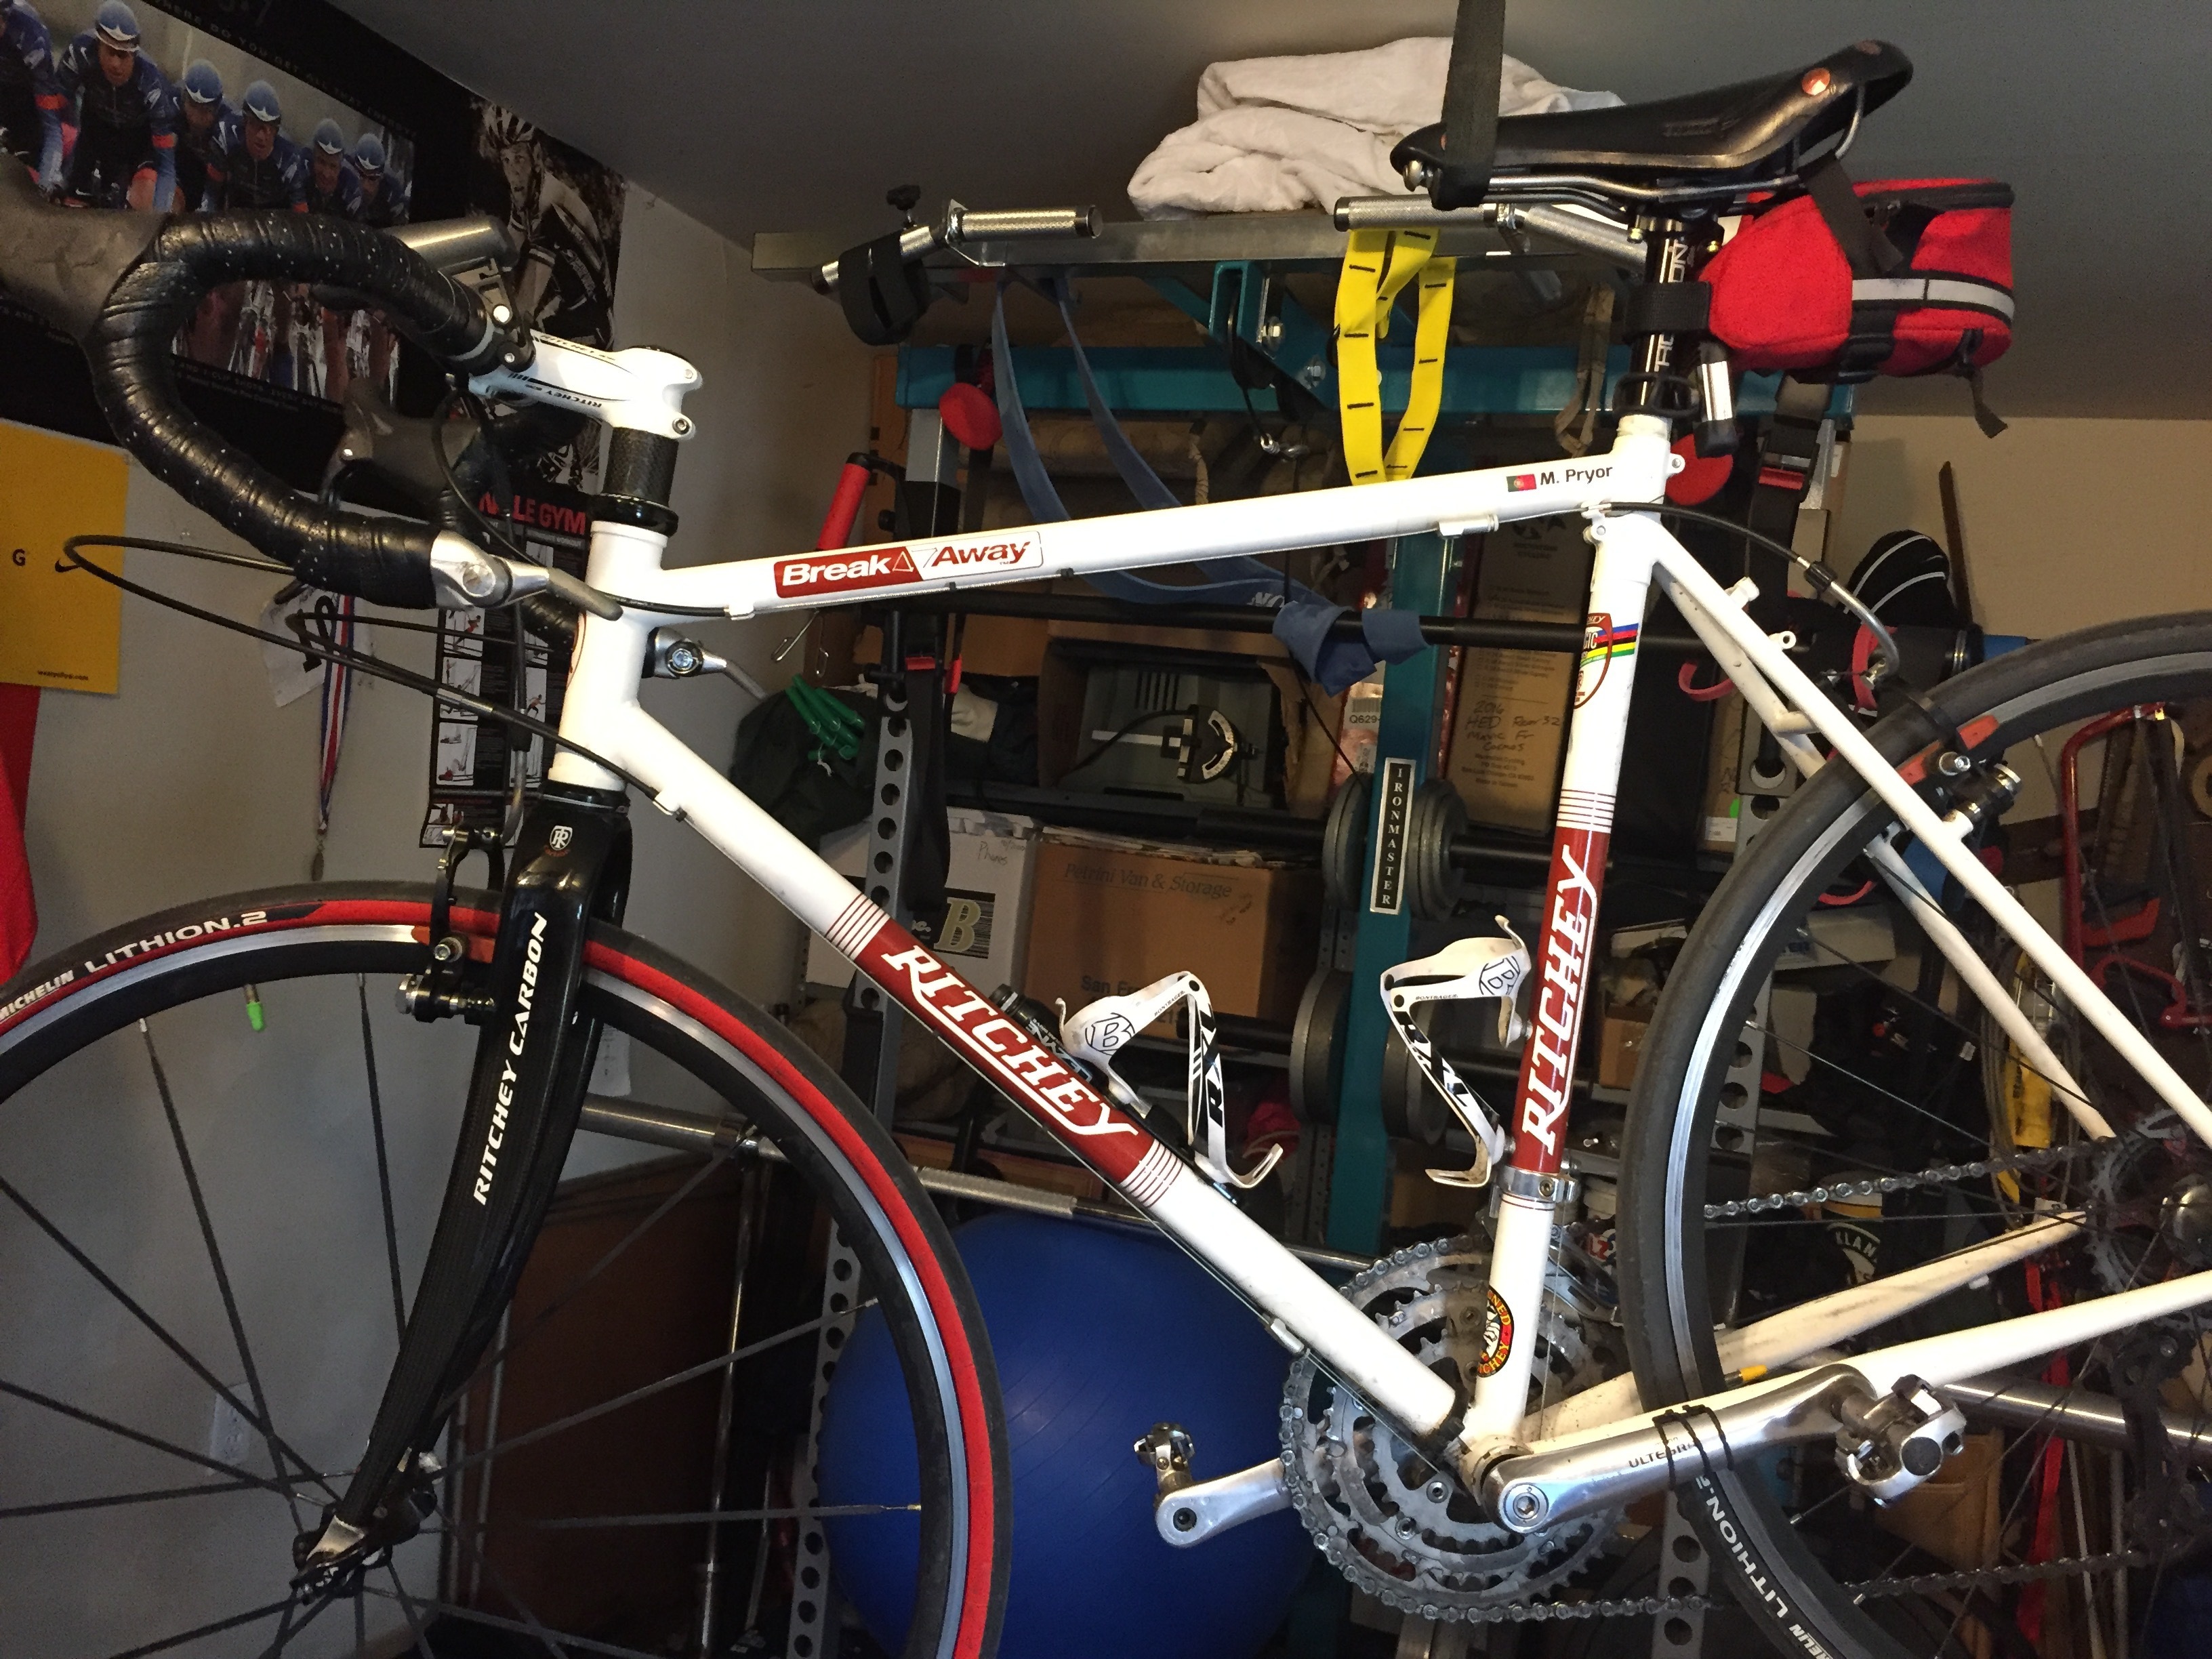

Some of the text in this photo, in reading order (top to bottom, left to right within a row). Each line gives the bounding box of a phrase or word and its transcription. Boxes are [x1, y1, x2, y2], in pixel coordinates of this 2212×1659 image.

[1540, 466, 1613, 486] M. Pryor
[539, 502, 586, 535] GYM
[12, 548, 26, 567] G
[782, 554, 892, 586] Break
[931, 541, 1031, 567] Away
[1381, 768, 1403, 905] IRONMASTER
[84, 911, 268, 974] LITHION.2
[1522, 844, 1597, 1156] RITCHEY
[474, 912, 548, 1205] RITCHEY CARBON
[882, 945, 1139, 1136] RITCHEY
[1025, 1019, 1093, 1083] LEZYNE
